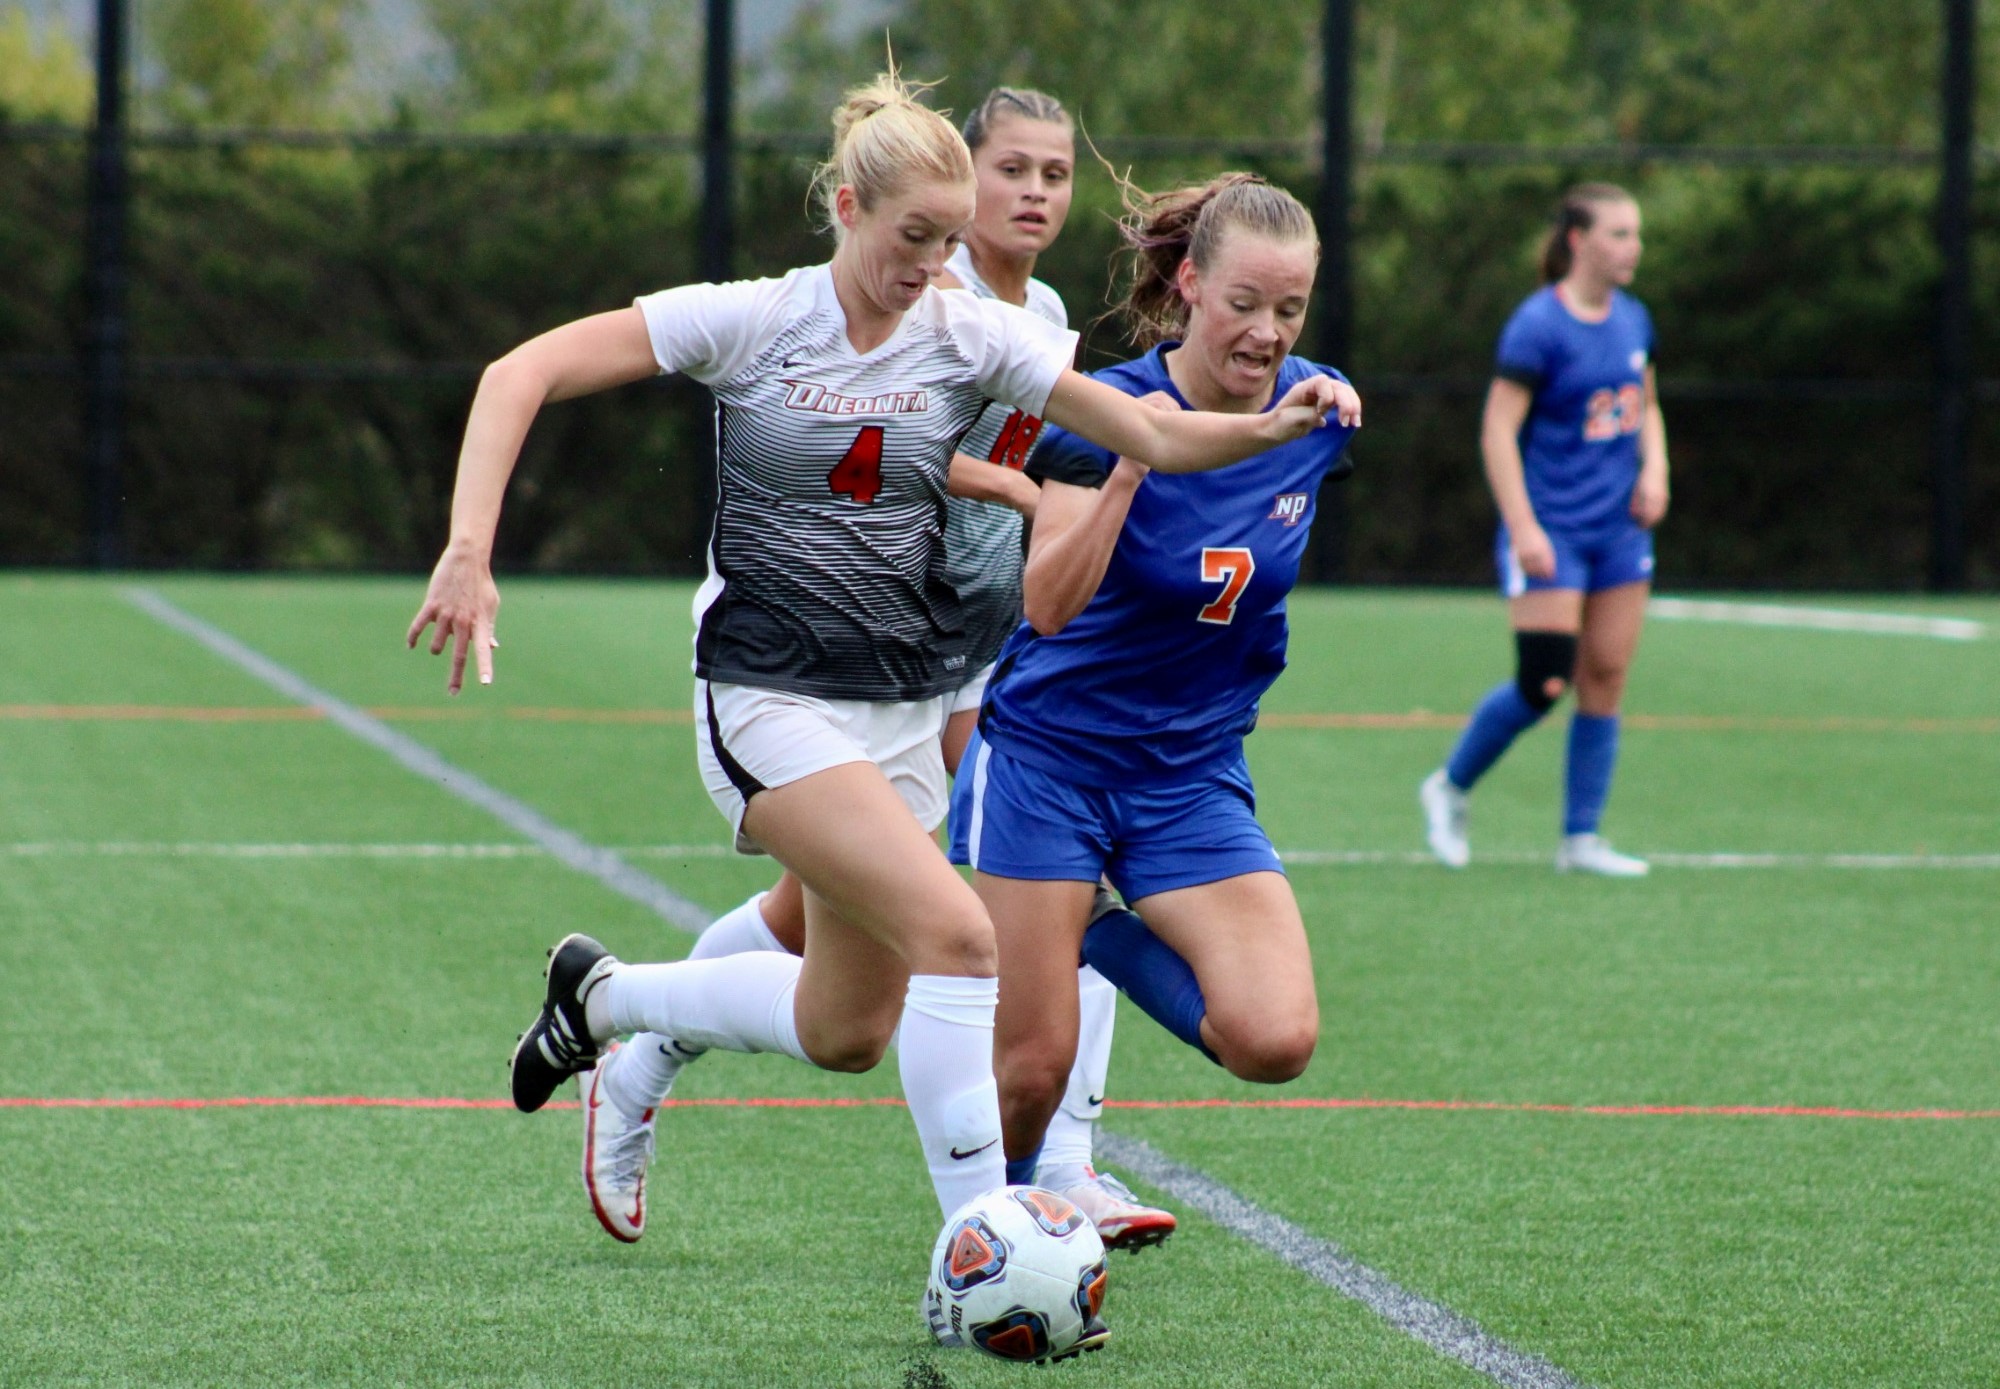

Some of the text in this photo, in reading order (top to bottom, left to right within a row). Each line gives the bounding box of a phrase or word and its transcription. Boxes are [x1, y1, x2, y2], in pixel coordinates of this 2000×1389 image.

[776, 379, 930, 414] ONEONTA
[827, 425, 885, 504] 4
[988, 408, 1043, 471] 18
[1269, 493, 1308, 526] NP
[1197, 547, 1255, 625] 7
